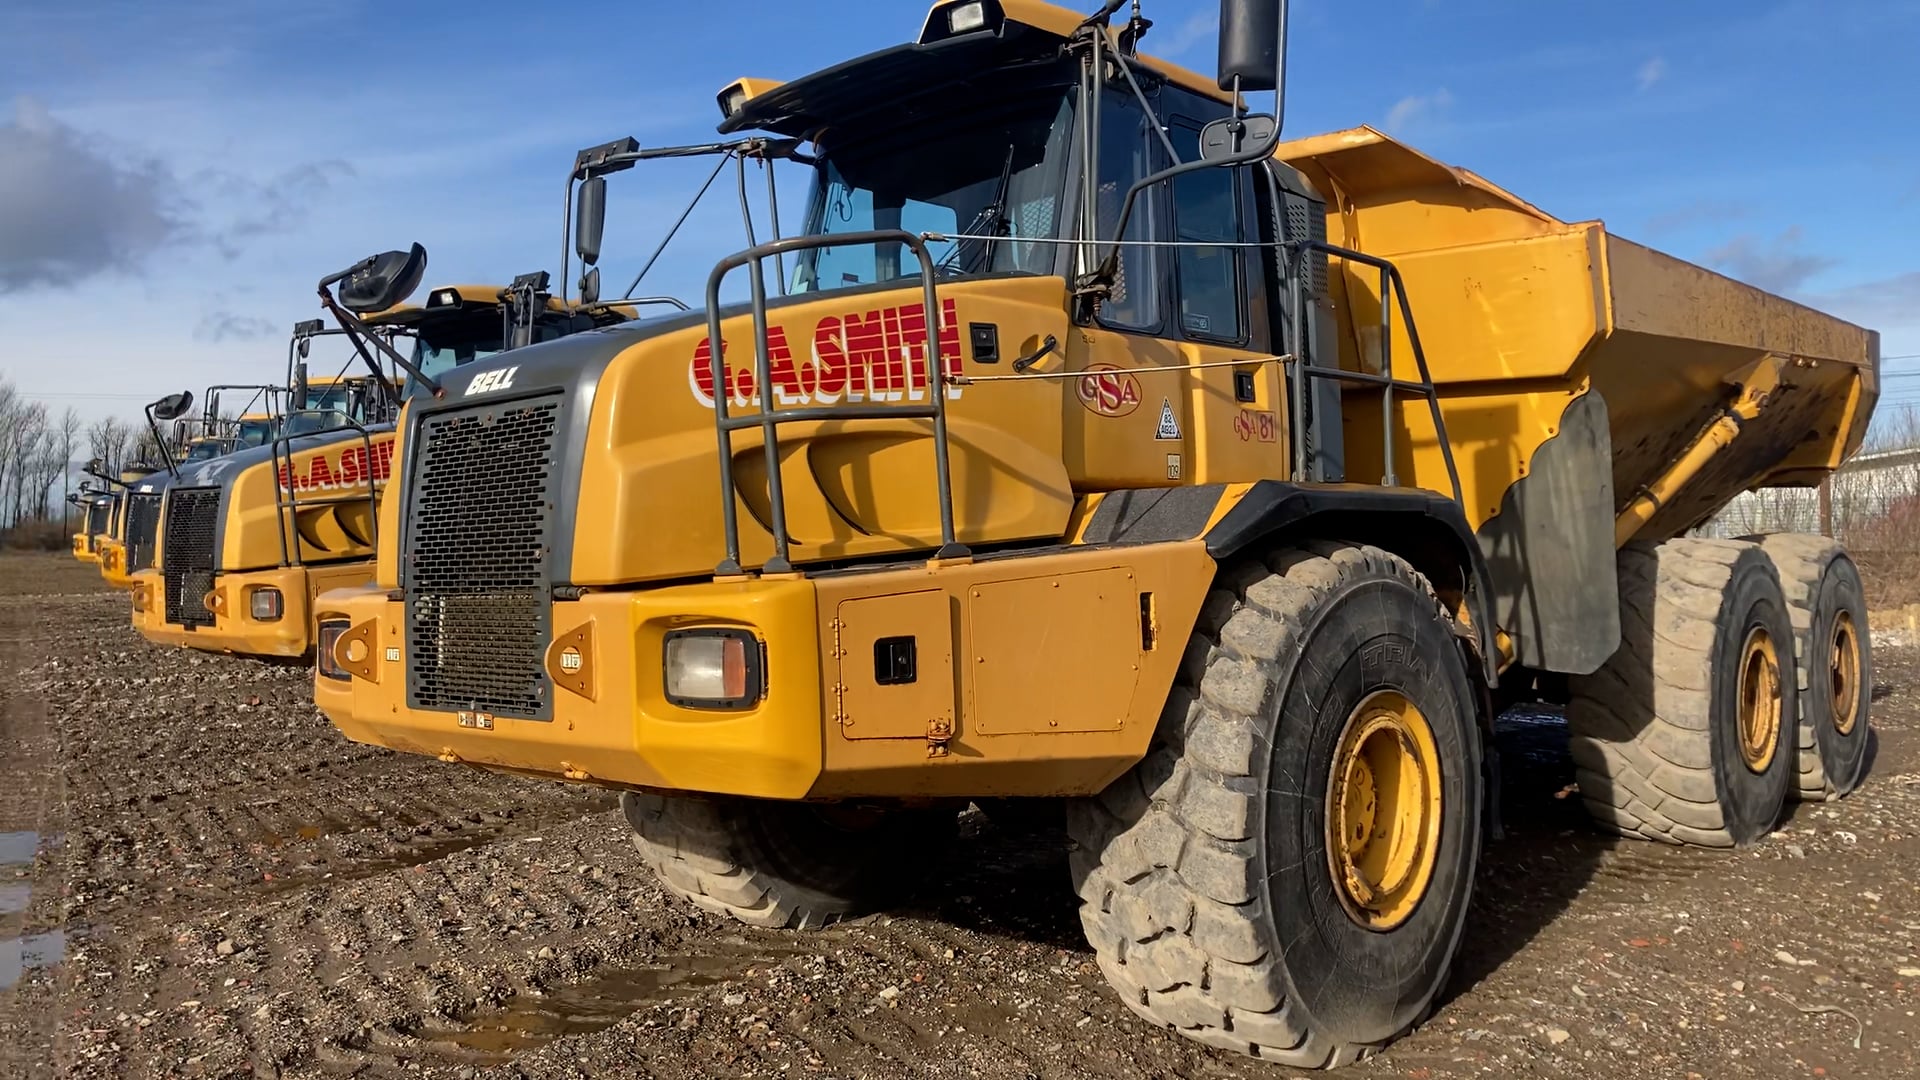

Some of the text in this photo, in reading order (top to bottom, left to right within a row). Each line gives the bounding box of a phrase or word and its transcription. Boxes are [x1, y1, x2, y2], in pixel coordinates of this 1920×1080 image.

[464, 366, 519, 396] BELL
[1080, 366, 1139, 413] GSA
[1233, 408, 1275, 441] GSA 81
